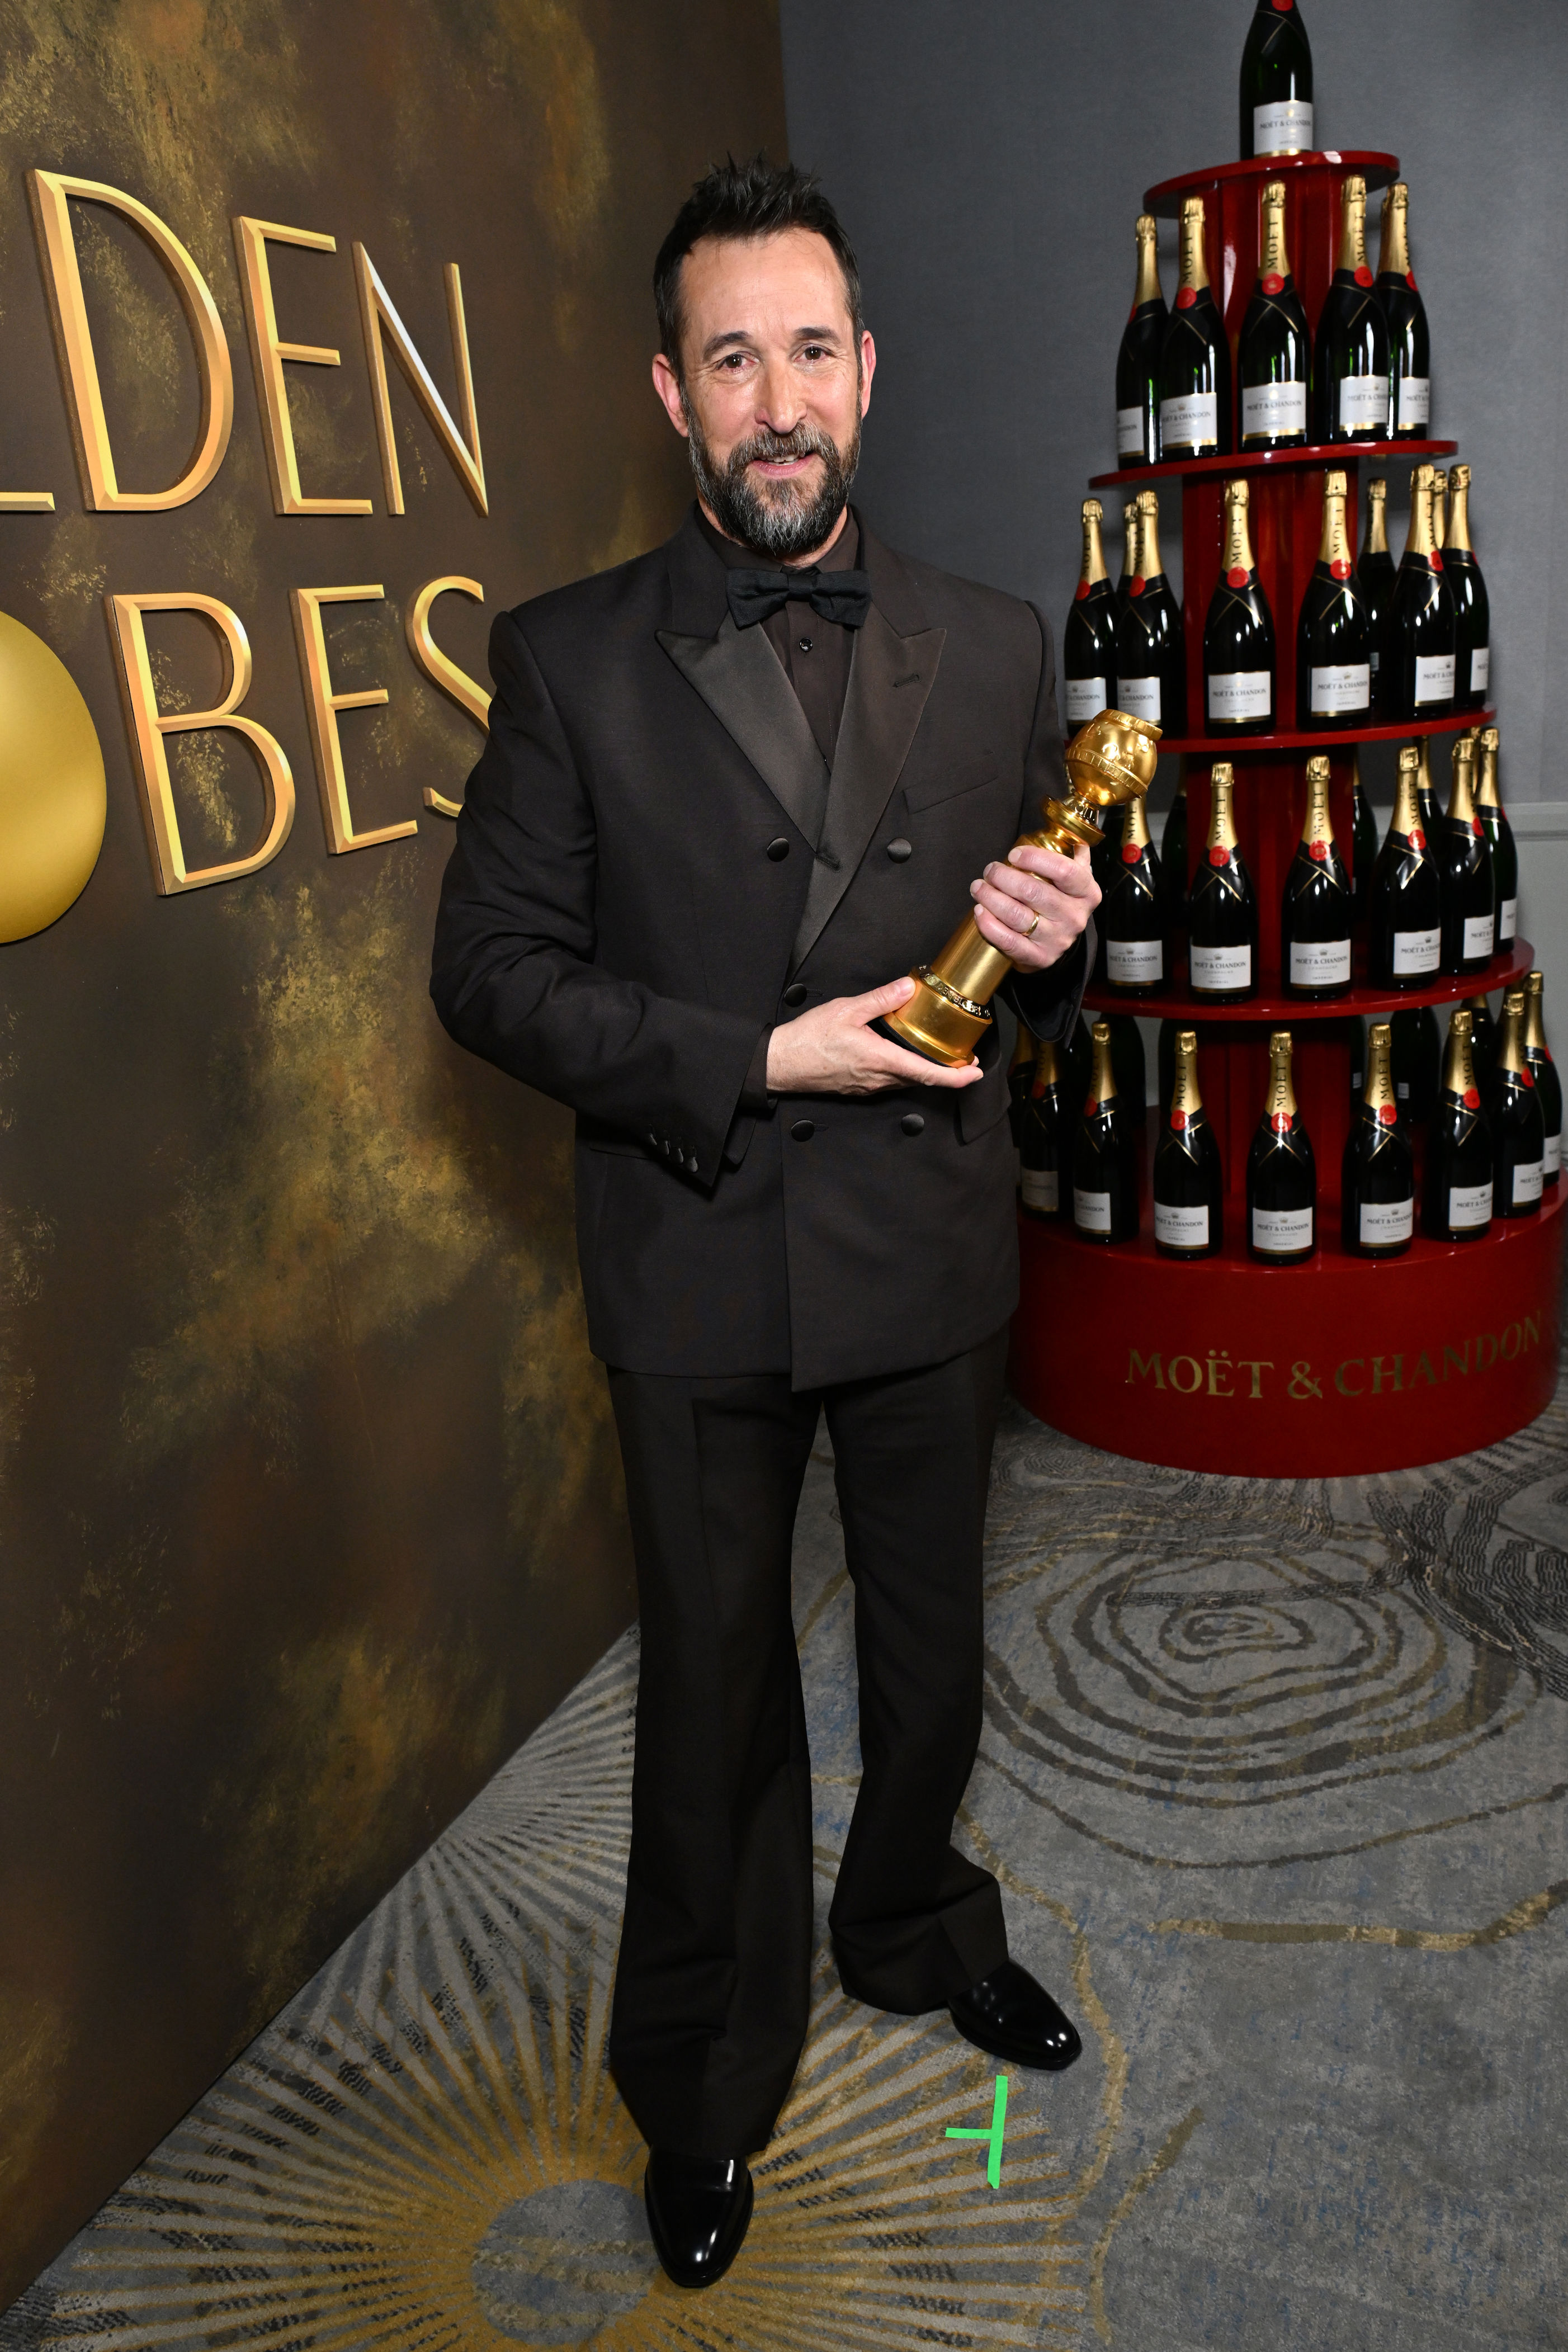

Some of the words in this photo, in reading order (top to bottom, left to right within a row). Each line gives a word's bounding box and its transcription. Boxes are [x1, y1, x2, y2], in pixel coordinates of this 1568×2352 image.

[0, 168, 489, 518] DEN
[1281, 1223, 1309, 1231] CHANDON
[1125, 1347, 1274, 1399] MOËT
[1287, 1361, 1324, 1400] &
[1334, 1310, 1543, 1397] CHANDON
